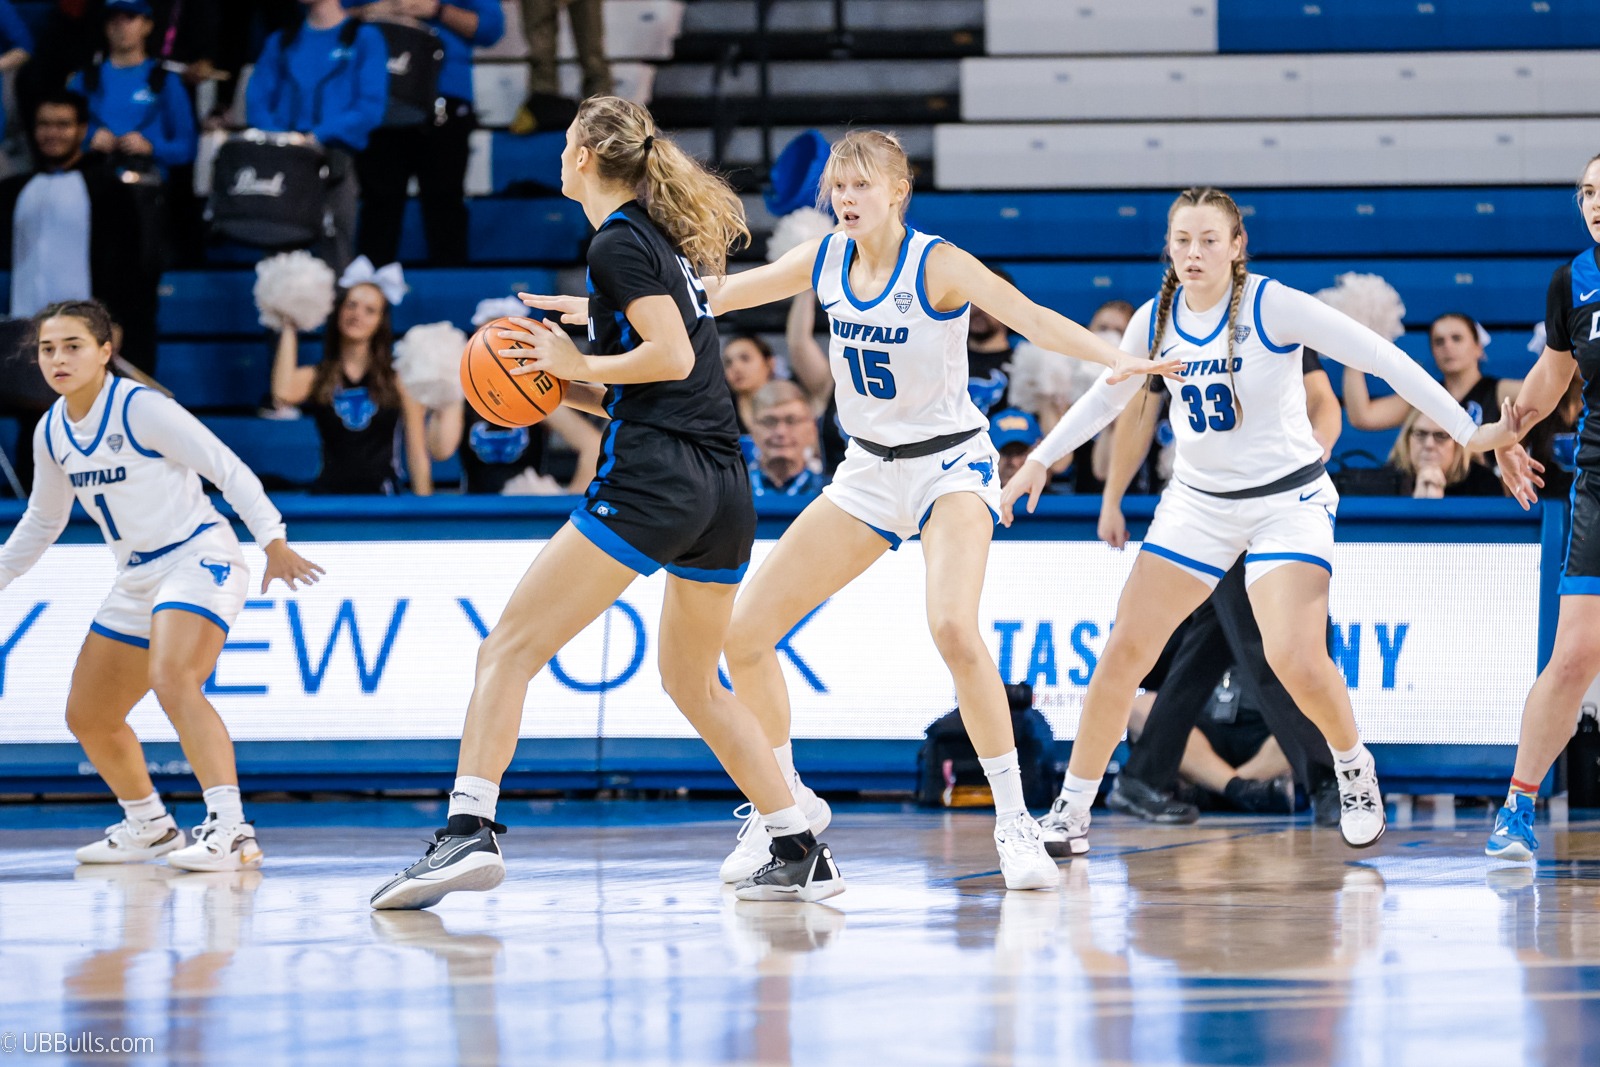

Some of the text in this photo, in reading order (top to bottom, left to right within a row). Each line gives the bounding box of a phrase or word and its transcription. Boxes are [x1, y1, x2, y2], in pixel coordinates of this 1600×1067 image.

[843, 346, 897, 400] 15
[1174, 357, 1243, 377] UFFALO
[1181, 383, 1236, 433] 33
[94, 493, 122, 541] 1
[203, 598, 411, 694] EW
[992, 620, 1119, 687] TAS
